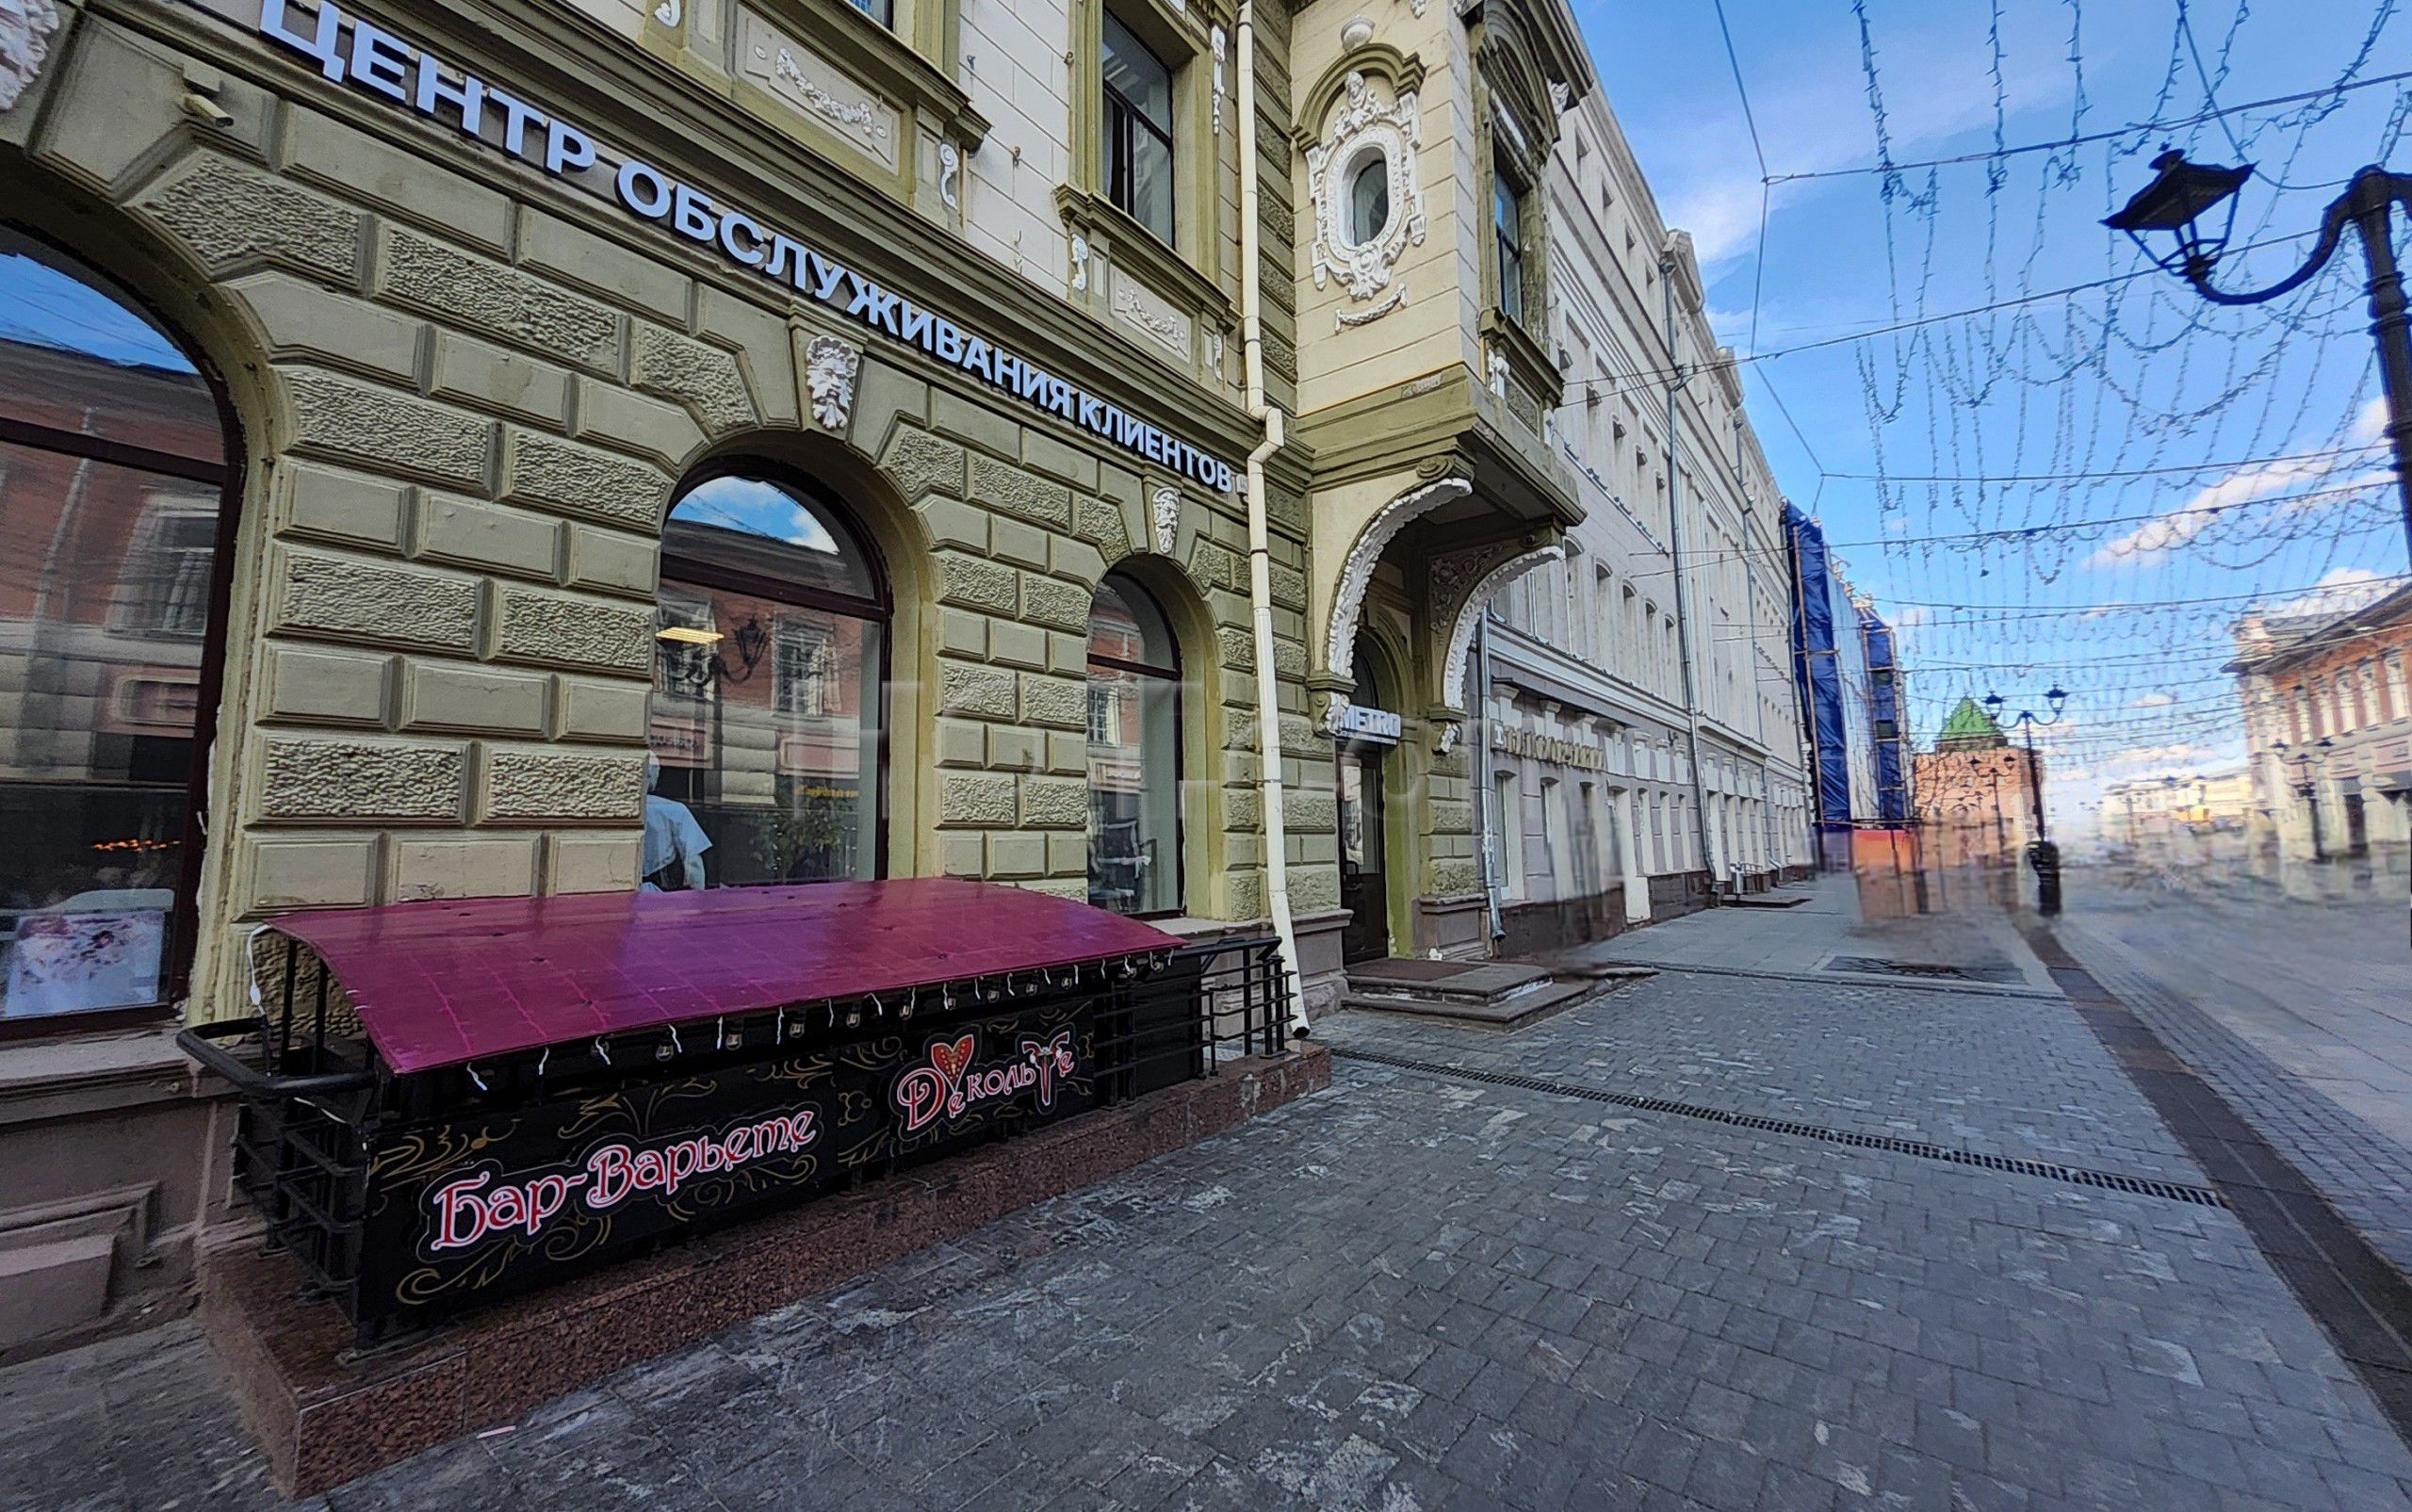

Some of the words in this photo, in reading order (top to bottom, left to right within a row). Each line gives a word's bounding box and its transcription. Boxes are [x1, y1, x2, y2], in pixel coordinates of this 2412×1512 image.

[259, 0, 596, 175] ЦЕНТР
[617, 159, 1072, 416] ОБСЛУЖИВАНИЯ
[1079, 392, 1232, 494] КЛИЕНТОВ
[897, 1032, 1075, 1130] Декольте
[431, 1111, 817, 1251] Бар-Варьете
